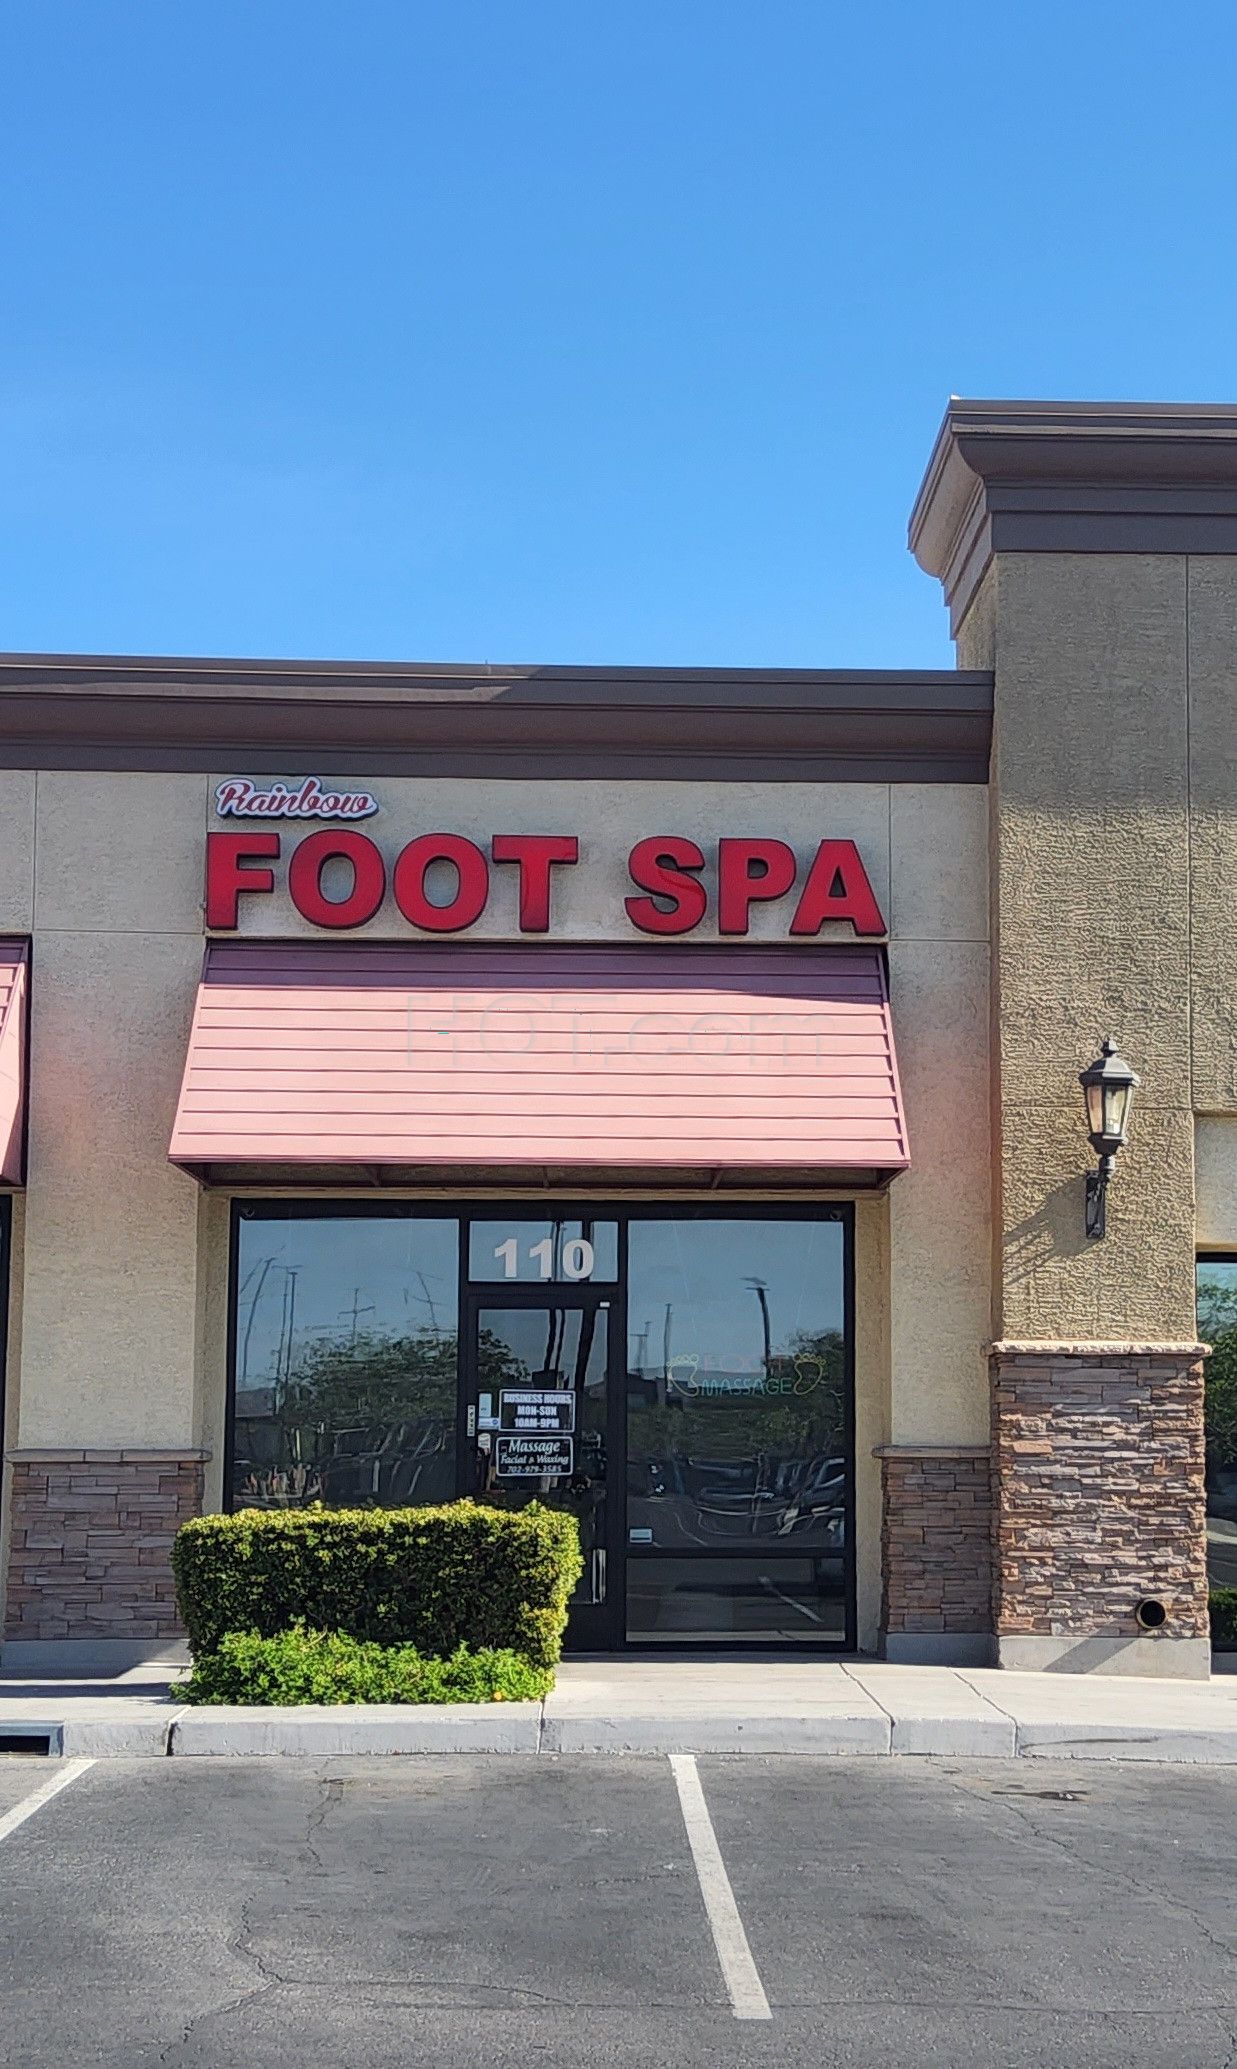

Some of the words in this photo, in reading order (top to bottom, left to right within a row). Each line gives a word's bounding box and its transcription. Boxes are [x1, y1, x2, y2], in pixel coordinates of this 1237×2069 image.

[217, 776, 377, 819] Rainbow
[206, 829, 579, 933] FOOT
[624, 836, 888, 936] SPA
[493, 1238, 595, 1280] 110
[701, 1377, 793, 1397] MASSAGE
[508, 1440, 560, 1454] Massage
